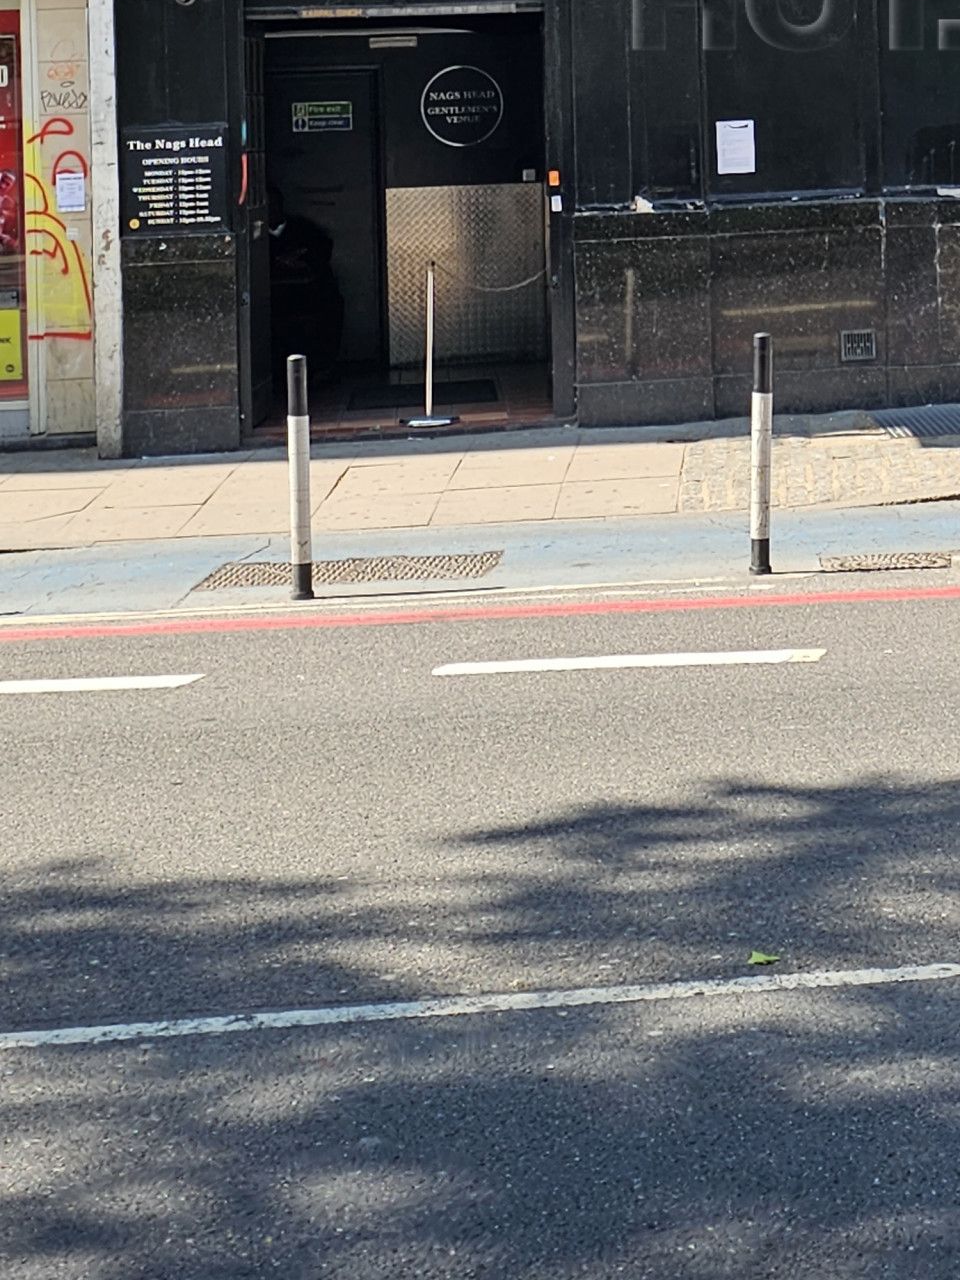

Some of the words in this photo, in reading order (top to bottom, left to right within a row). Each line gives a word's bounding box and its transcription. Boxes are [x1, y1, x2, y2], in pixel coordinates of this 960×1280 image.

[429, 91, 461, 101] NAGS
[127, 140, 152, 151] The
[155, 139, 187, 152] Nags
[189, 136, 223, 148] Head
[142, 157, 180, 166] OPENING
